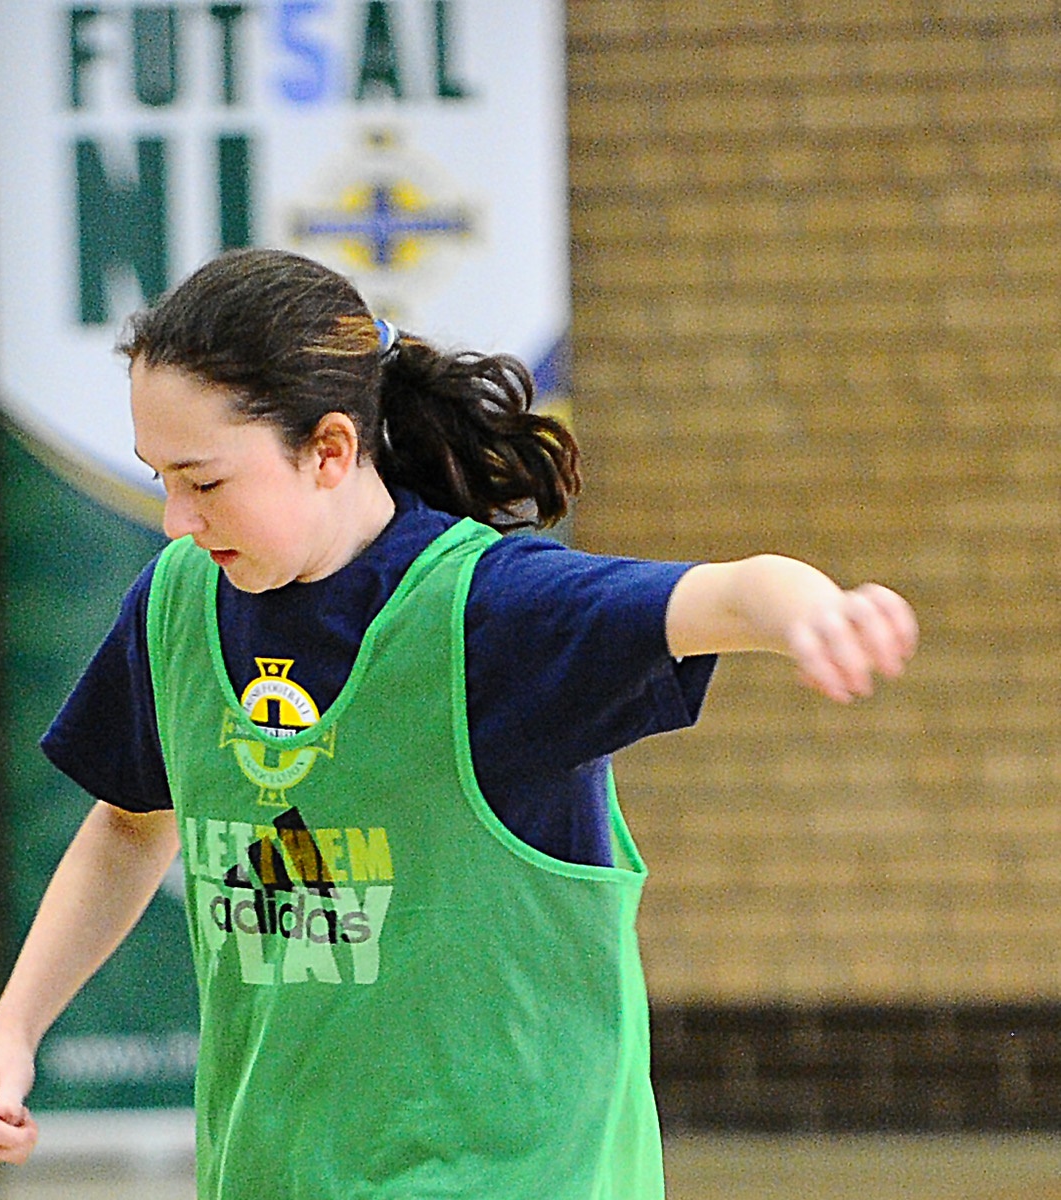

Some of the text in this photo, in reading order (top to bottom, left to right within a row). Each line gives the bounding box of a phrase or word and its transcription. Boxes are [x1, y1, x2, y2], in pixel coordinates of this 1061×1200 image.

[68, 0, 473, 106] FUTSAL
[74, 134, 252, 327] NI
[186, 817, 394, 882] LET THEM
[195, 880, 394, 986] PLAY
[209, 889, 372, 945] adidas
